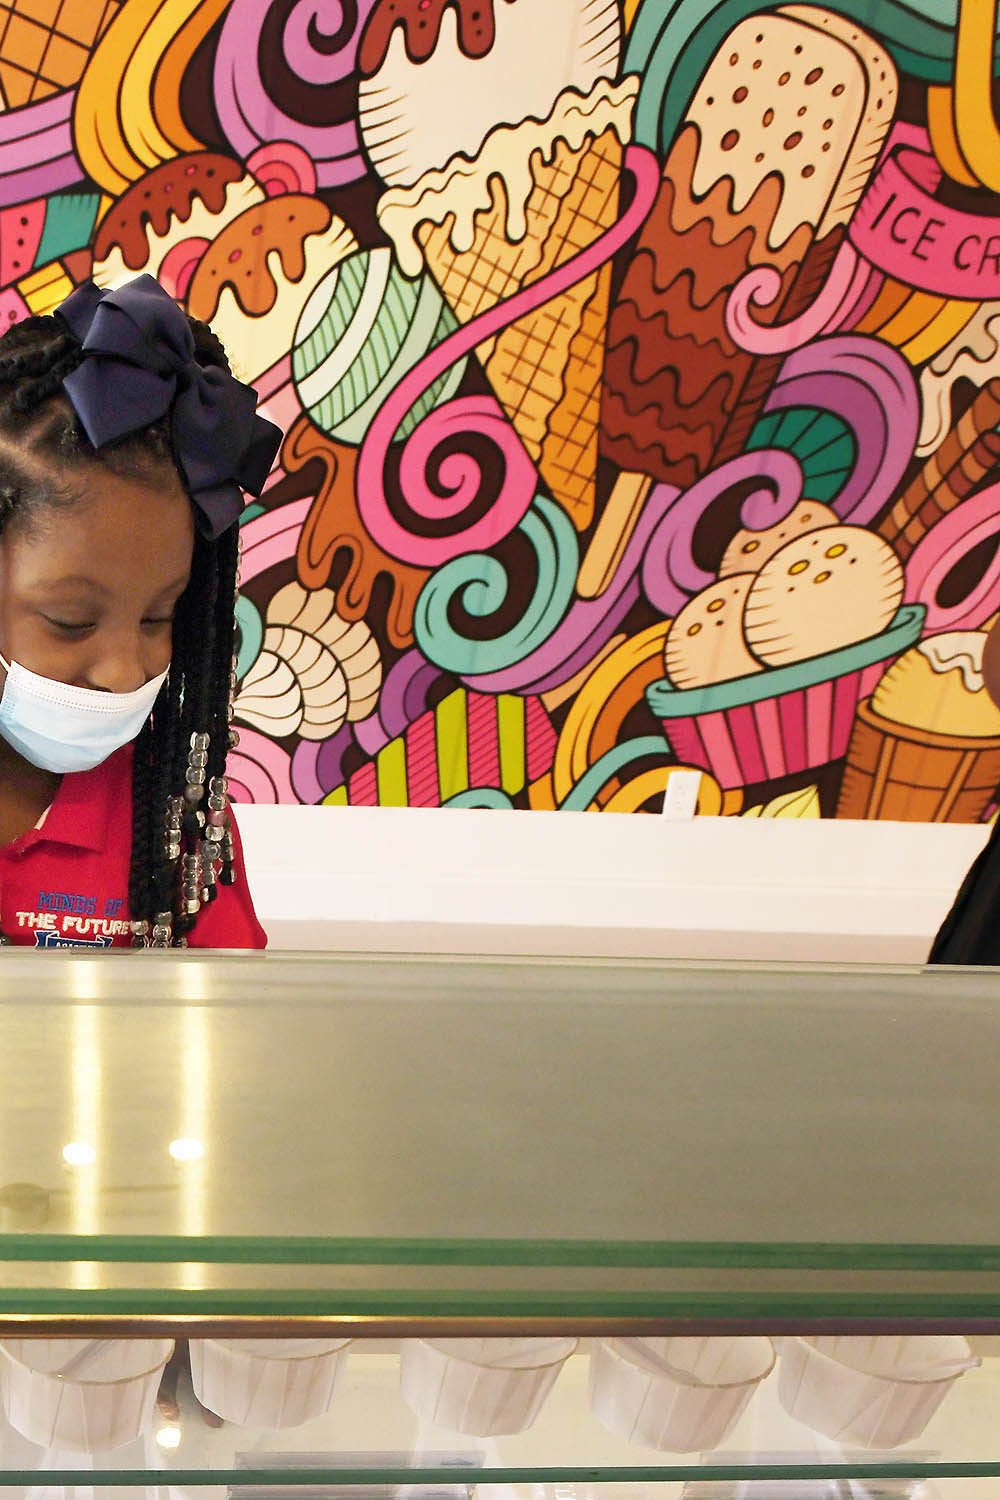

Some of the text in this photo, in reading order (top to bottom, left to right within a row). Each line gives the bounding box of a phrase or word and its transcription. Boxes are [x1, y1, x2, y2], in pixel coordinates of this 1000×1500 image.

[869, 192, 946, 262] ICE
[37, 891, 124, 917] MINDS OF
[15, 911, 129, 936] THE FUTURE
